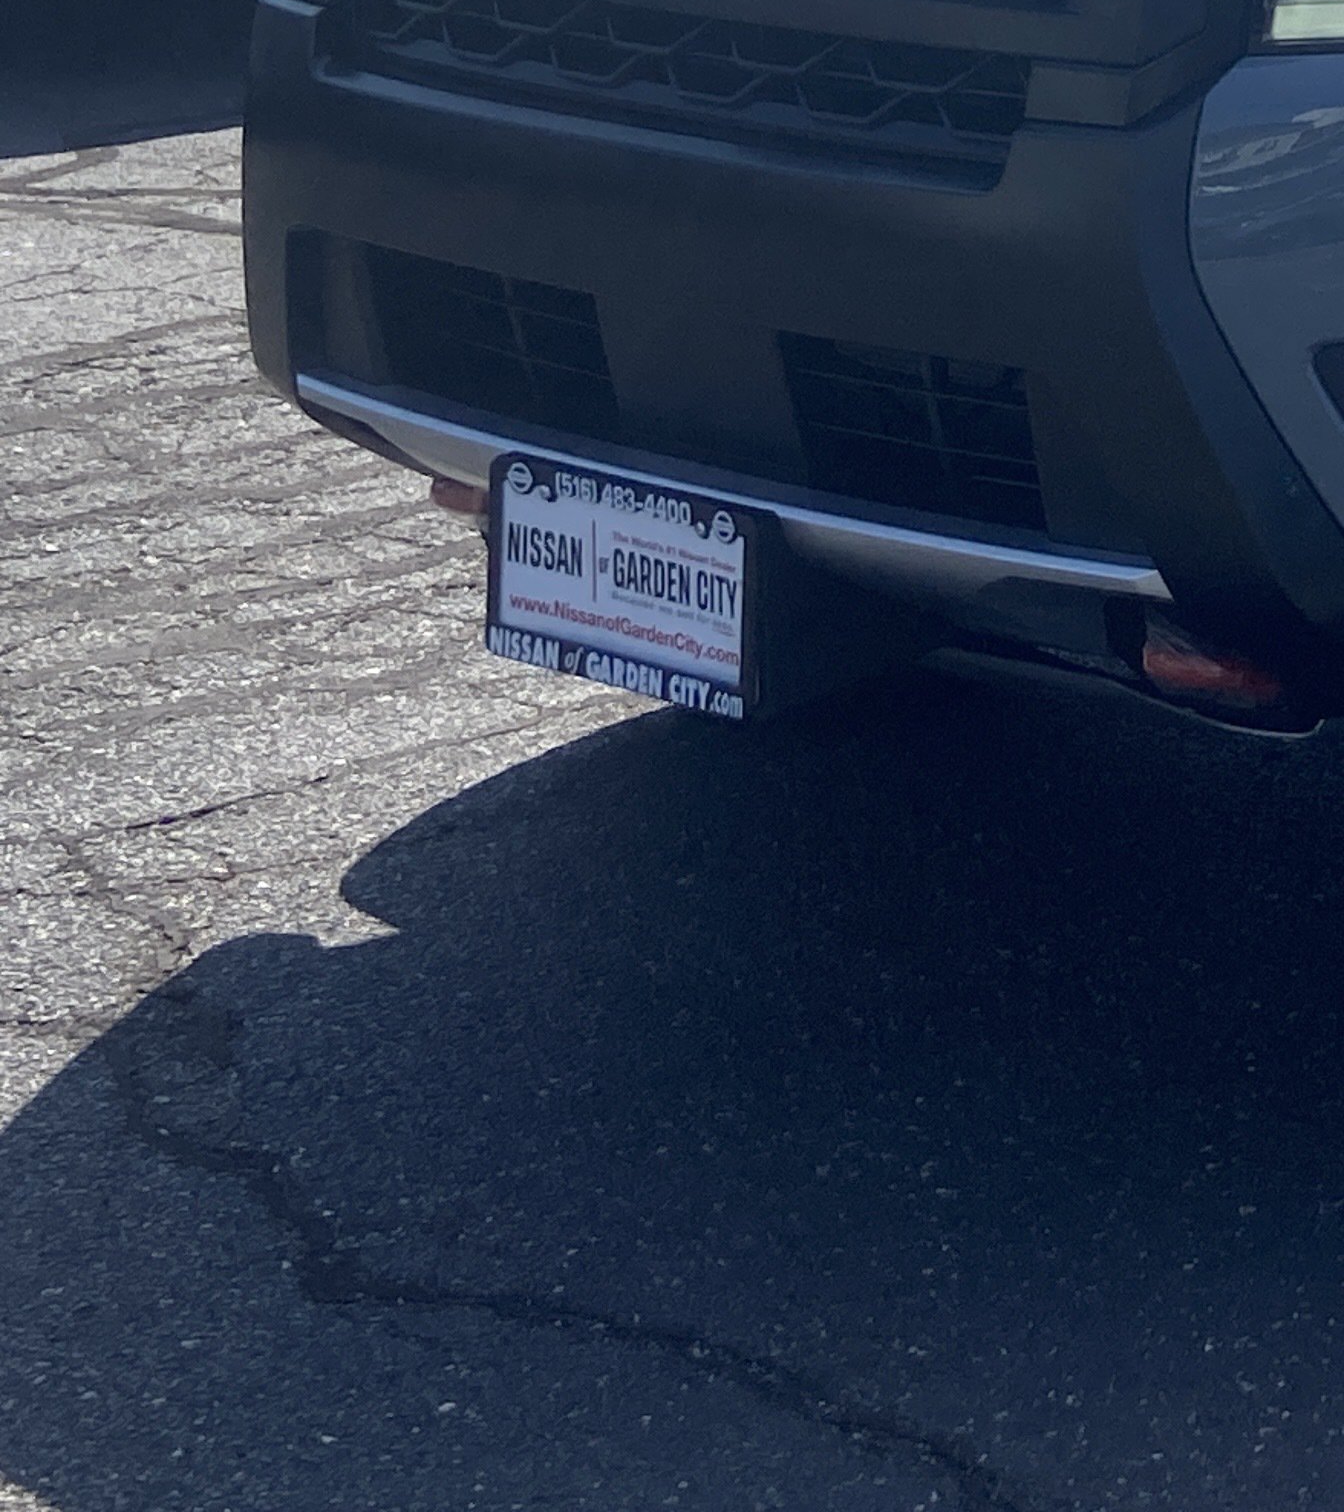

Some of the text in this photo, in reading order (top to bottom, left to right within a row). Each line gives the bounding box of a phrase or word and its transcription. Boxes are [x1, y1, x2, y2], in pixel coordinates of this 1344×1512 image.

[555, 471, 693, 528] (516) 483-4400
[507, 521, 582, 579] NISSAN
[612, 547, 691, 607] GARDEN
[696, 569, 738, 619] CITY
[489, 625, 560, 671] NISSAN
[564, 648, 581, 675] of
[585, 650, 665, 699] GARDEN
[508, 591, 740, 667] www.NissanofGardenCity.com
